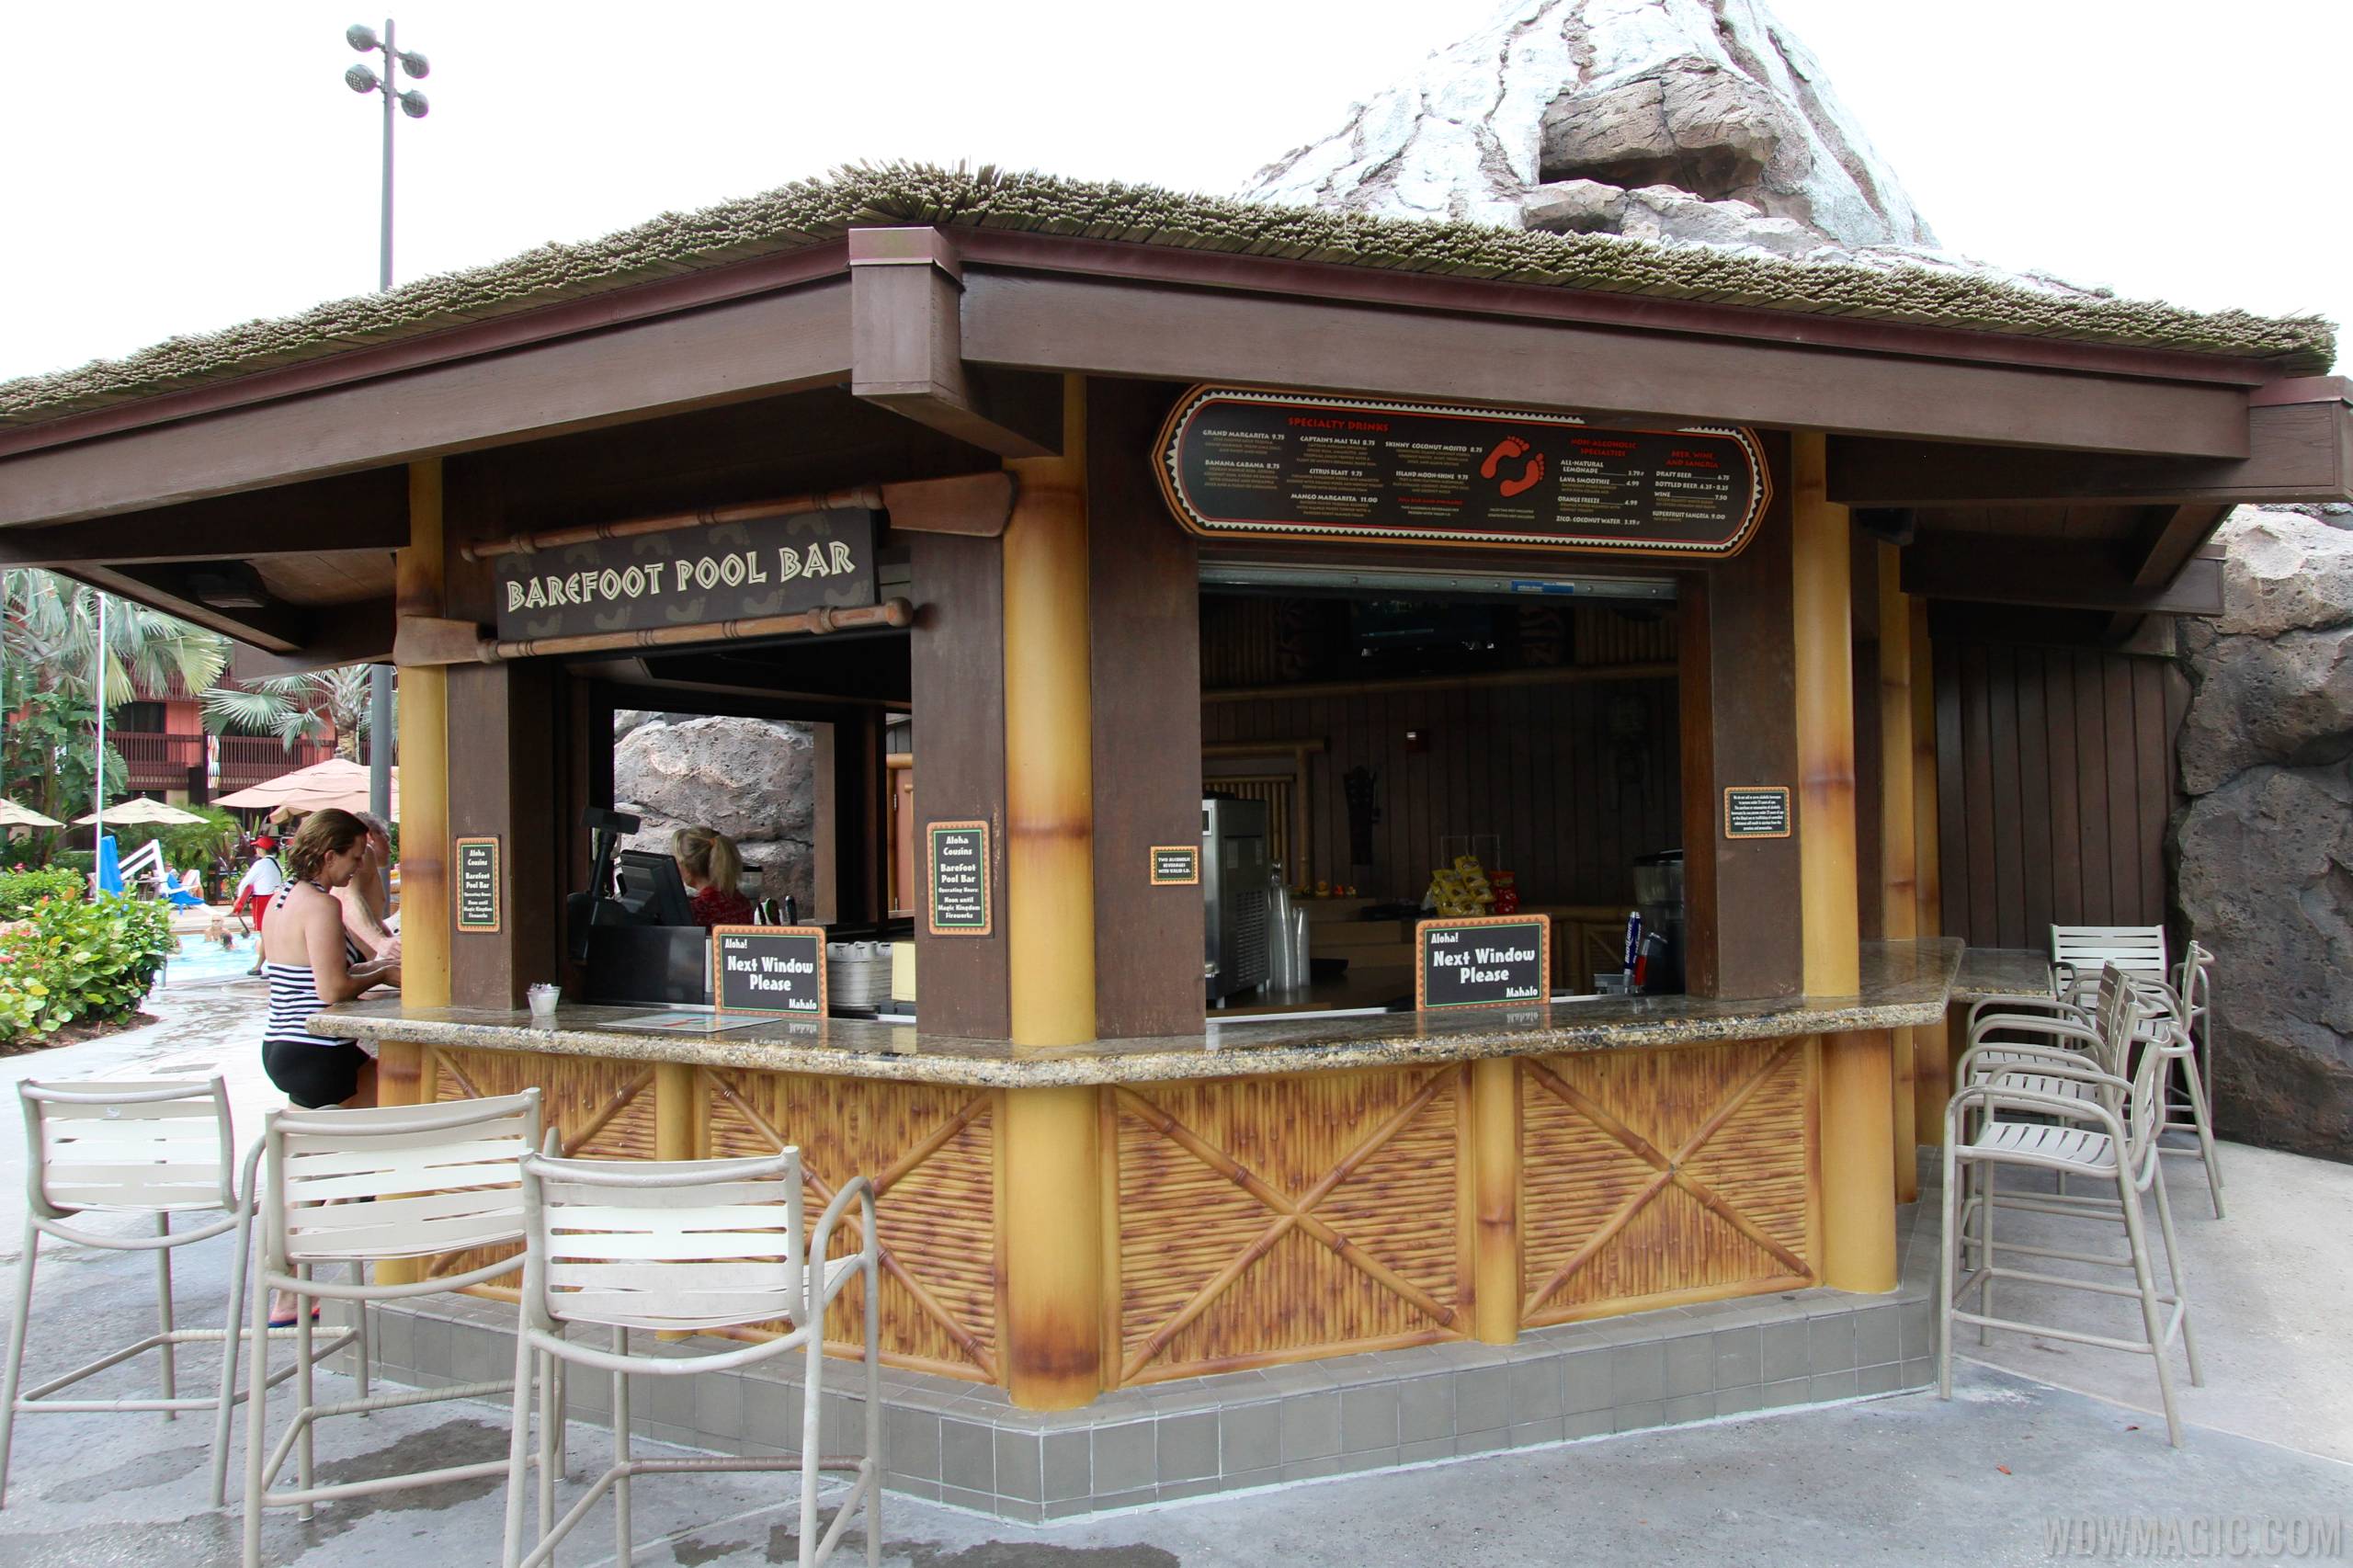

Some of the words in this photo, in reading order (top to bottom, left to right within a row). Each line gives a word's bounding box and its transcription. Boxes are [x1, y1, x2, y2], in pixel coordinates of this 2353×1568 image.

[1288, 417, 1345, 429] SPECIALTY
[1347, 420, 1389, 432] DRINKS
[1228, 431, 1269, 439] MARGARITA
[1235, 460, 1264, 469] CABANA
[1576, 477, 1610, 485] SMOOTHIE
[1317, 494, 1357, 502] MARGARITA
[506, 562, 665, 613] BAREFOOT
[675, 551, 768, 592] POOL
[778, 540, 857, 585] BAR
[946, 835, 969, 845] Aloha
[943, 846, 972, 856] Cousins
[940, 863, 976, 872] Barefoot
[940, 874, 959, 883] Pool
[961, 874, 976, 883] Bar
[724, 938, 748, 949] Aloha!
[1430, 932, 1459, 944] Aloha!
[1433, 950, 1471, 967] Next
[1474, 947, 1535, 964] Window
[727, 955, 757, 972] Next
[761, 956, 813, 974] Window
[1460, 966, 1509, 984] Please
[749, 973, 791, 991] Please
[1506, 985, 1538, 998] Mahalo
[789, 998, 817, 1010] Mahalo
